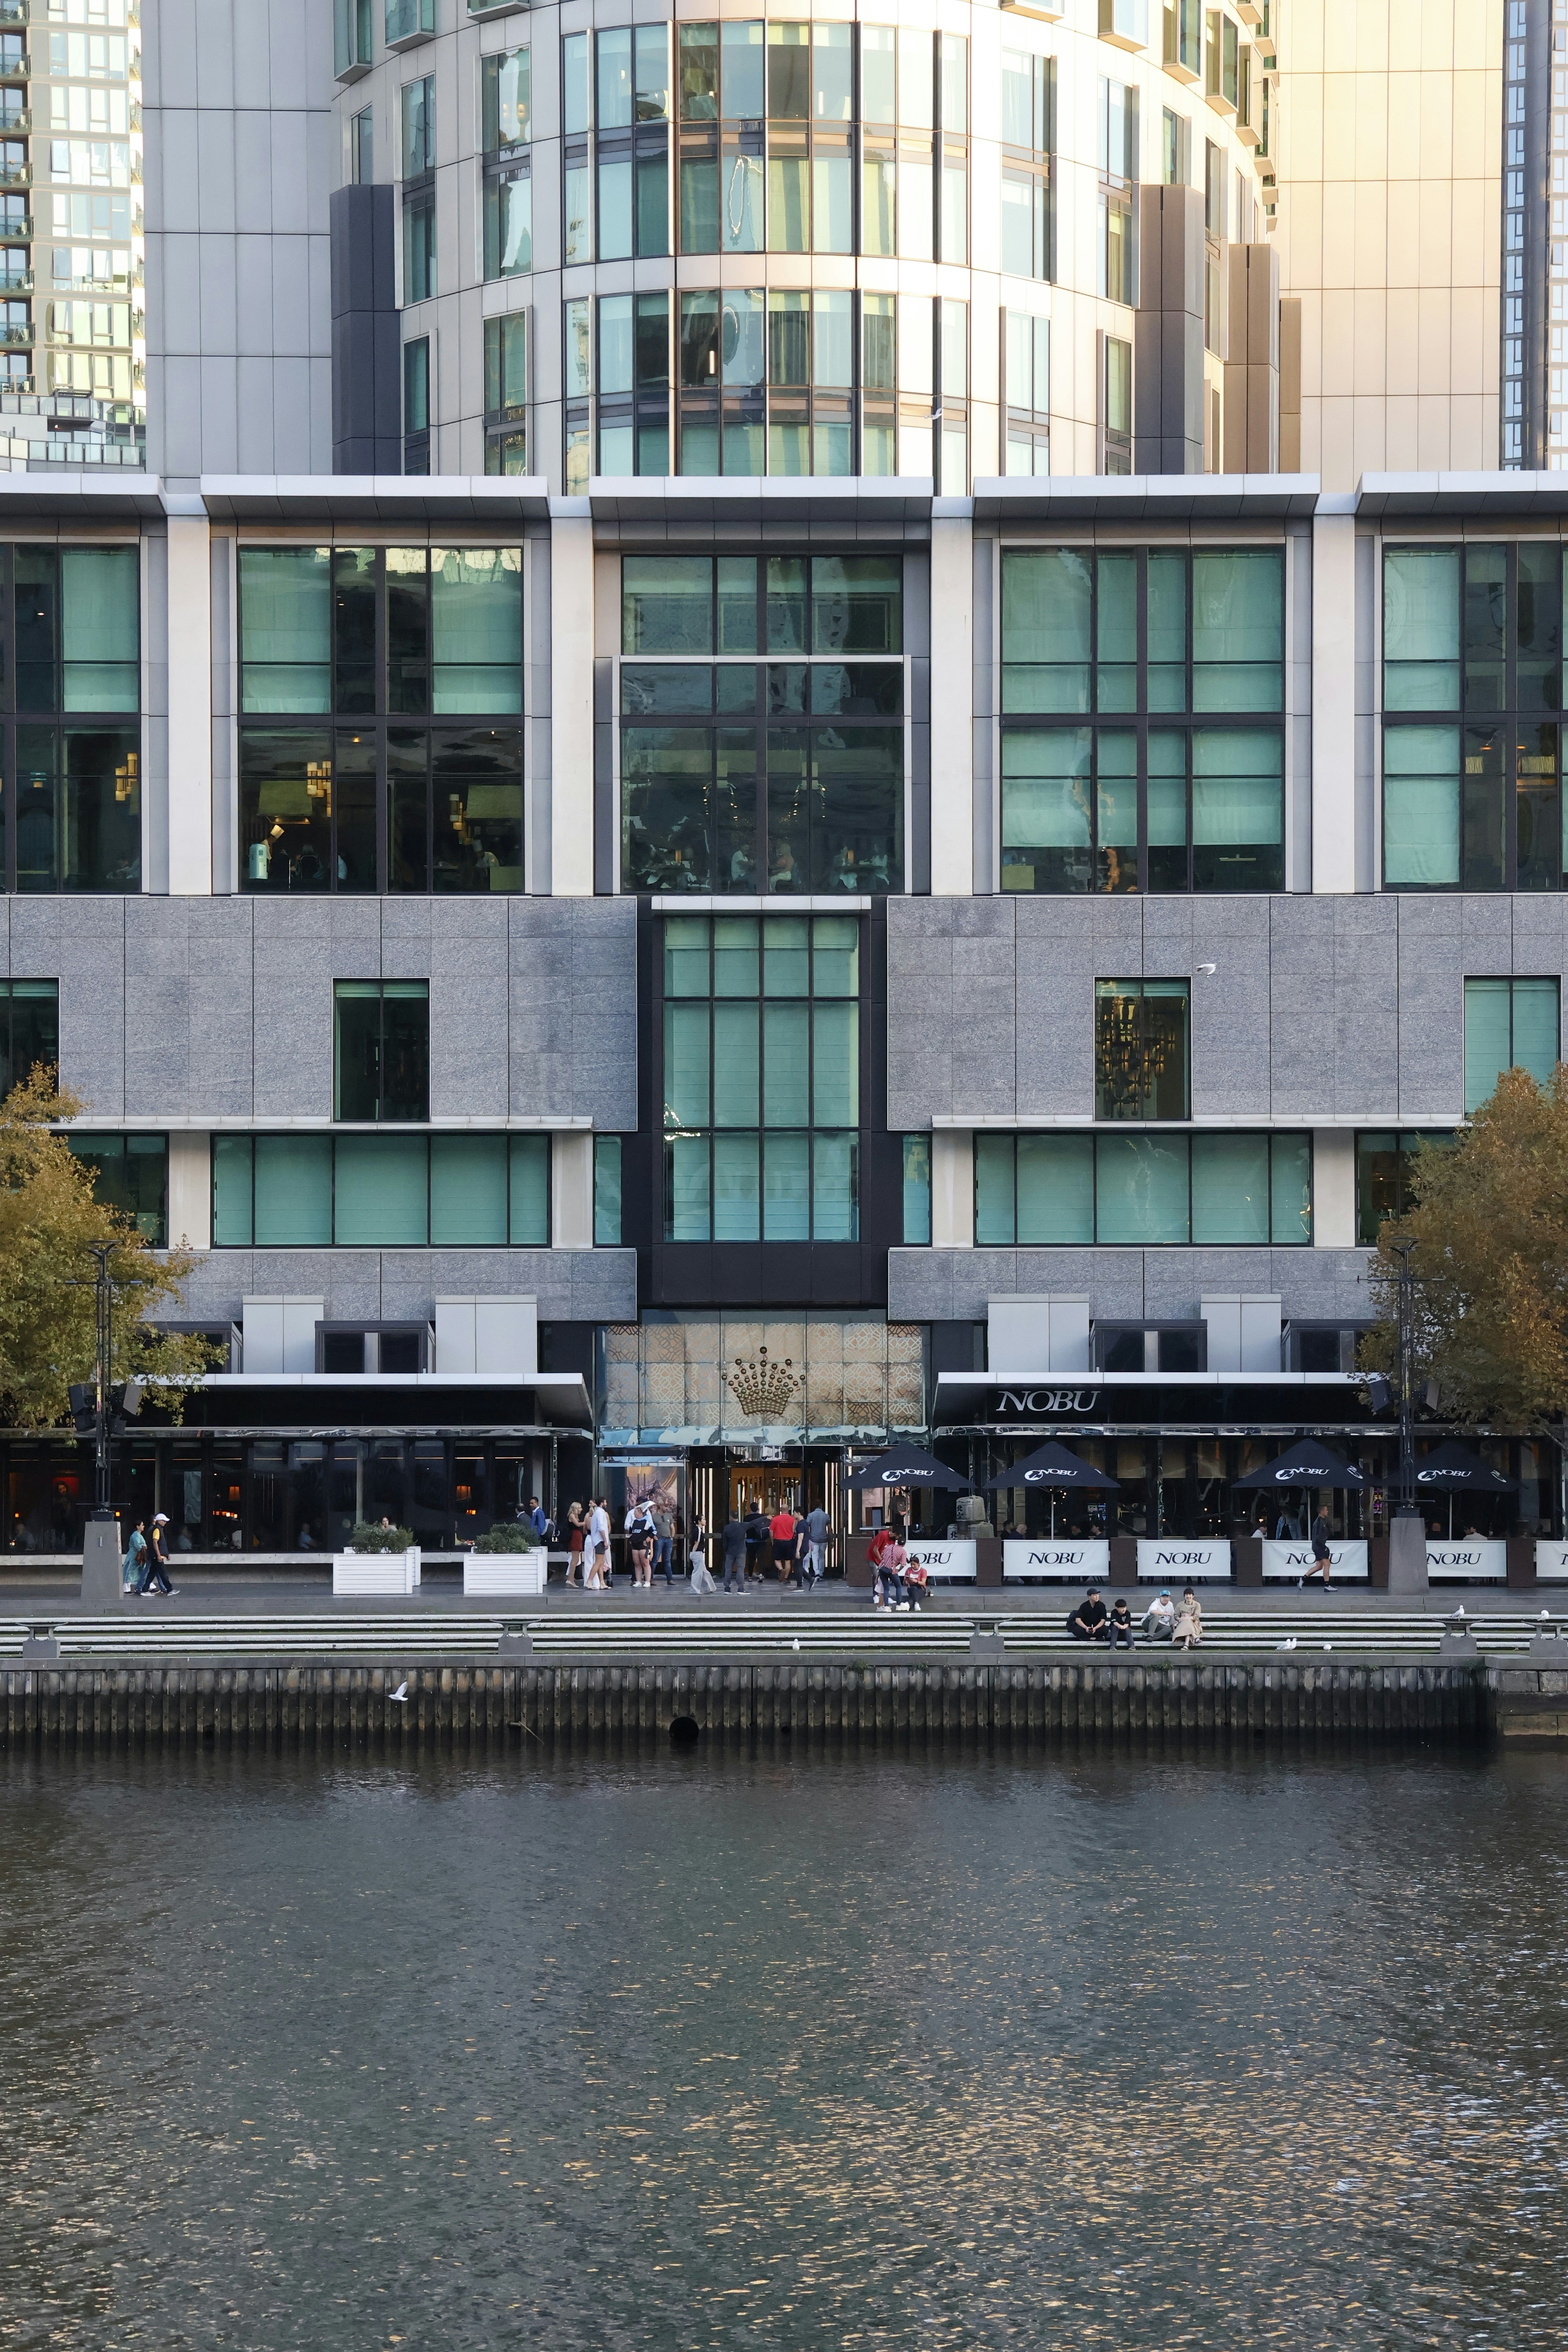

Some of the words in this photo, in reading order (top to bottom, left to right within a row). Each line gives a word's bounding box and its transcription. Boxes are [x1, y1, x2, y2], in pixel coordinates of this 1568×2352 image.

[996, 1391, 1101, 1411] NOBU
[1027, 1552, 1085, 1564] NOBU
[1154, 1552, 1213, 1564] NOBU
[1285, 1553, 1345, 1564] NOU
[1426, 1553, 1483, 1565] NOBU
